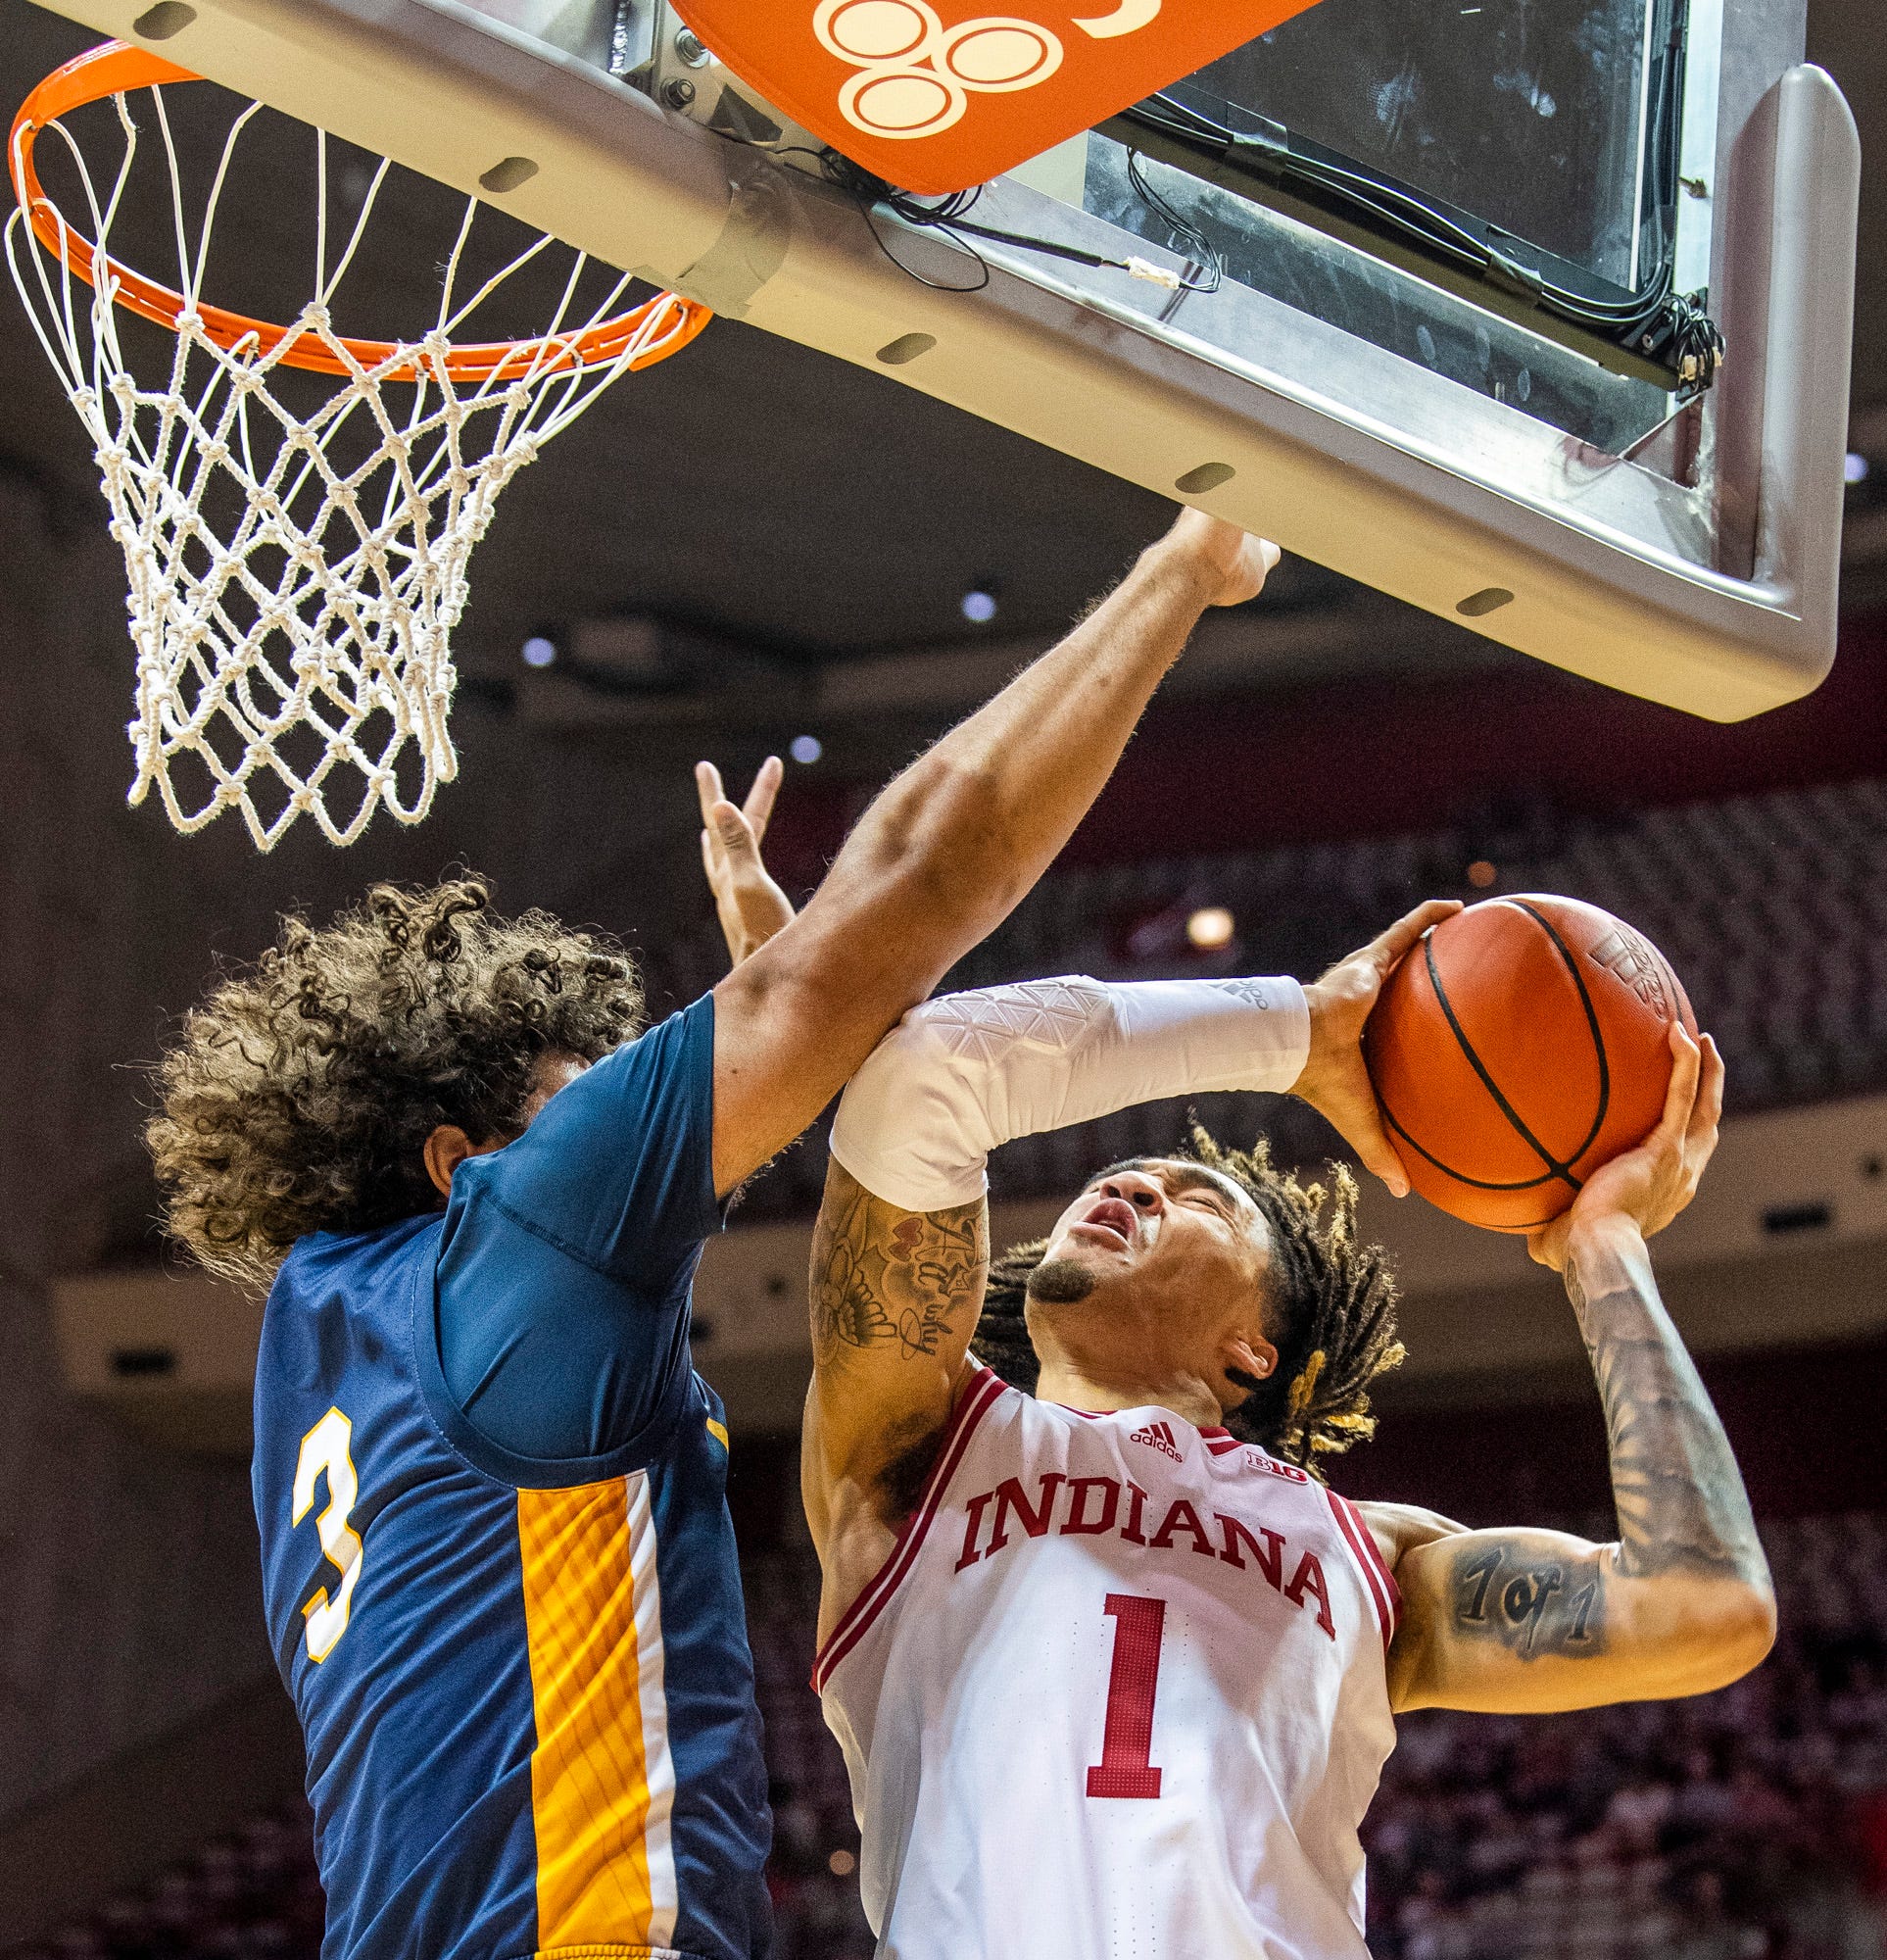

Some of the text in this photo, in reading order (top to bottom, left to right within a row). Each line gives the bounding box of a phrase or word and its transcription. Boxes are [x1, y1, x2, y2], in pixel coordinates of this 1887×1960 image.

[1130, 1433, 1184, 1463] adidas
[292, 1405, 363, 1664] 3
[954, 1473, 1335, 1642] INDIANA
[1461, 1546, 1597, 1649] 1 of 1
[1087, 1593, 1167, 1800] 1
